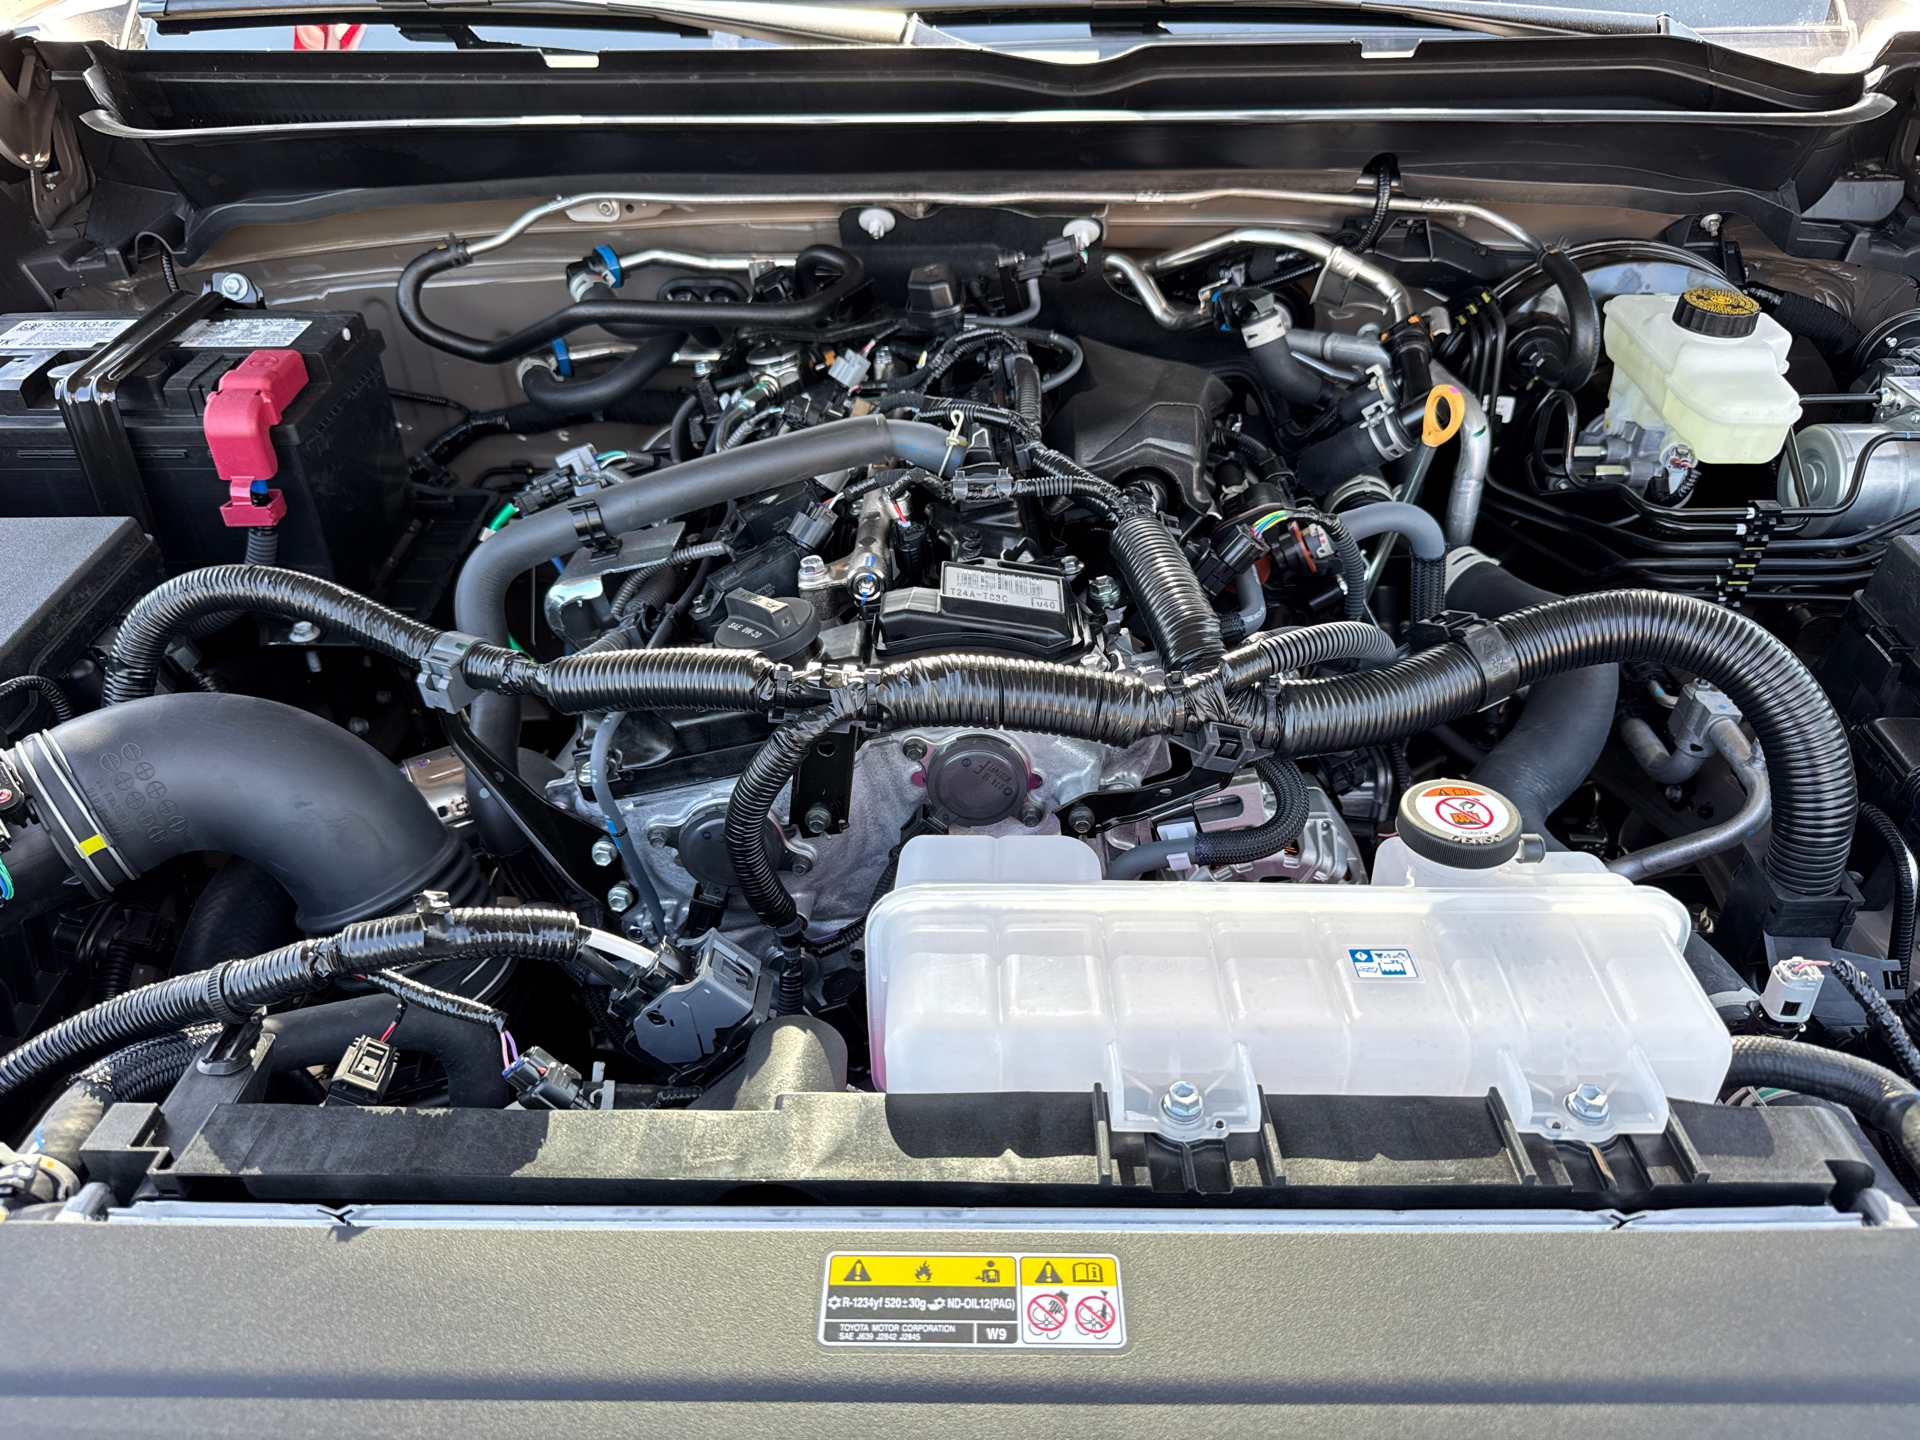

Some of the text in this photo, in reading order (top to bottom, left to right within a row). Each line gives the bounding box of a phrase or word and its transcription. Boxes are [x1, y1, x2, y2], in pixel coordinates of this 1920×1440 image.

[1452, 834, 1501, 845] DENSO
[842, 1297, 1016, 1311] R-1234yf 520±30g ND-OIL12(PAG)
[840, 1323, 956, 1333] TOYOTA MOTOR CORPORATION
[838, 1332, 921, 1341] SAE J639 J2842 J2845
[986, 1327, 1008, 1341] W9
